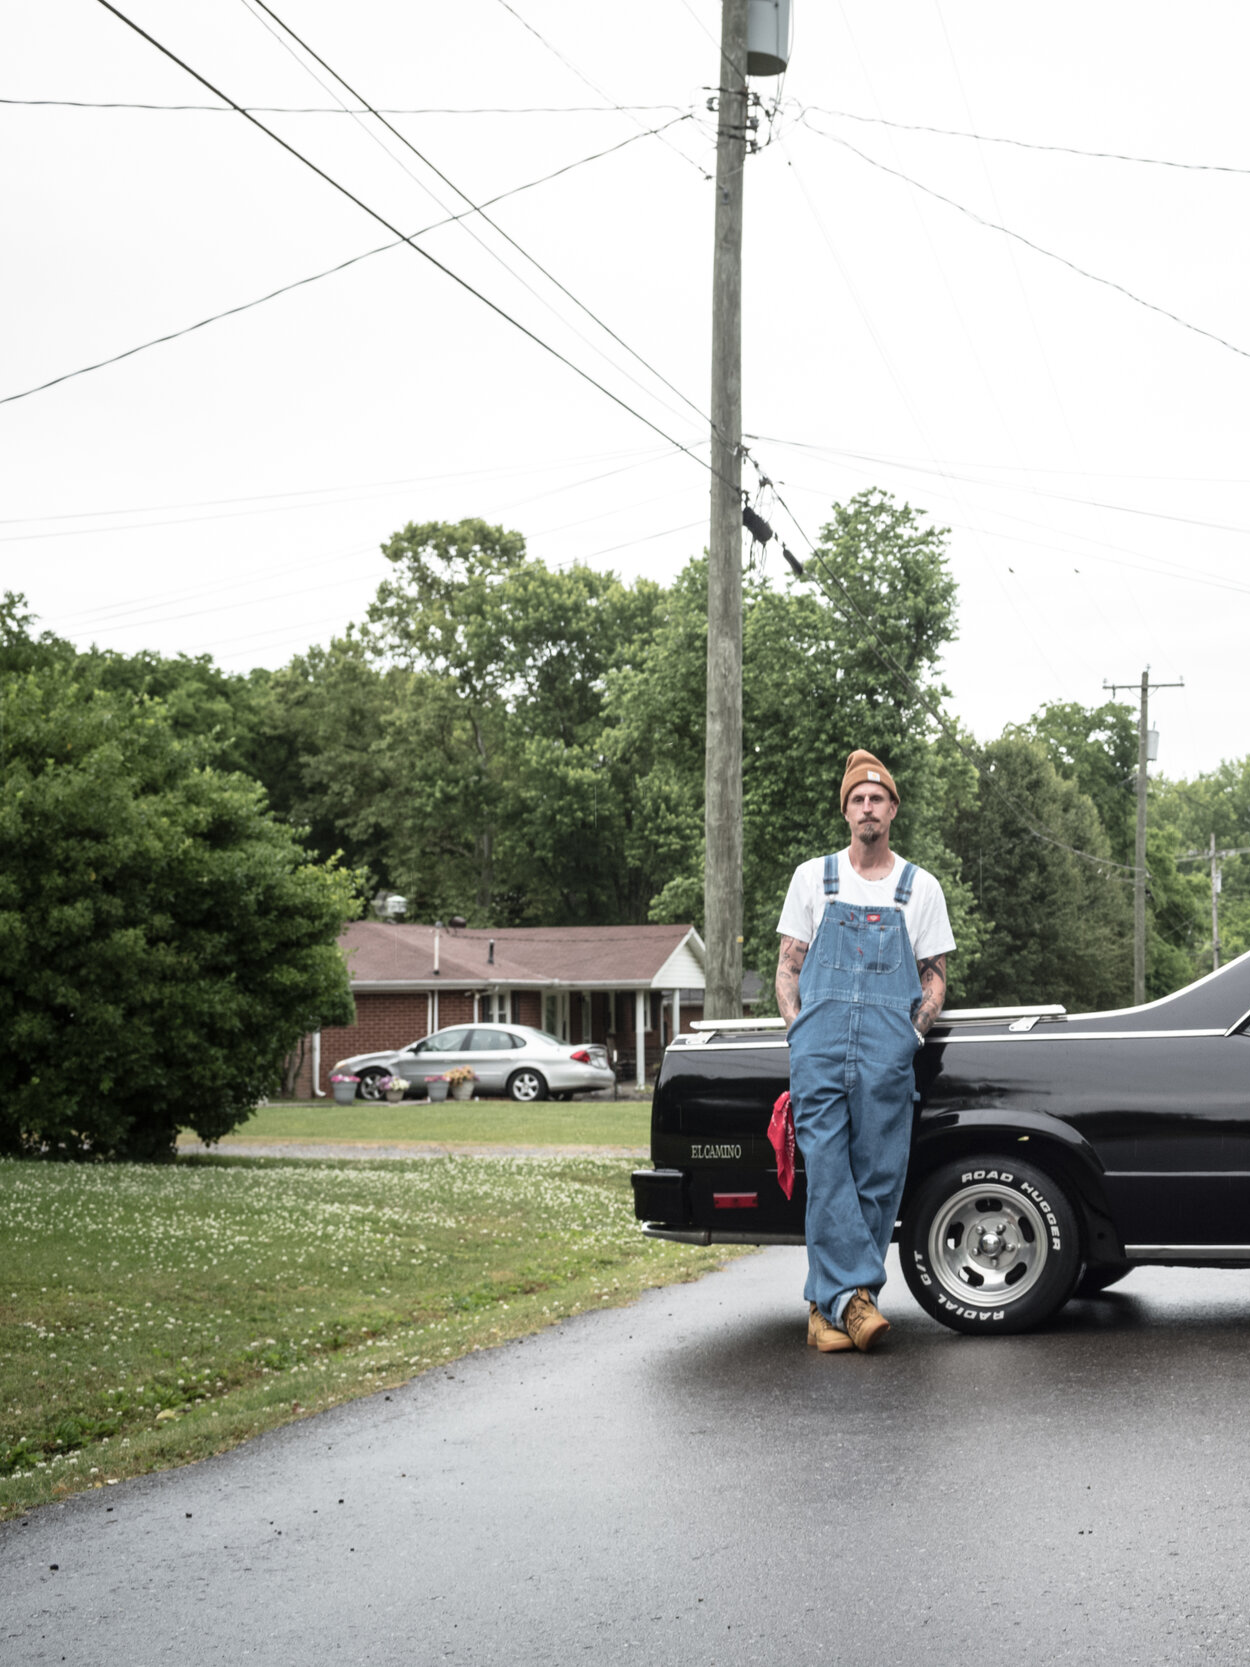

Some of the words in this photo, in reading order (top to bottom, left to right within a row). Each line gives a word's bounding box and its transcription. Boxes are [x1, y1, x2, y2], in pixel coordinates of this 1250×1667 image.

[961, 1170, 1014, 1183] ROAD
[1020, 1181, 1061, 1250] HUGGER
[914, 1250, 932, 1286] G/T
[938, 1293, 1004, 1320] RADIAL
